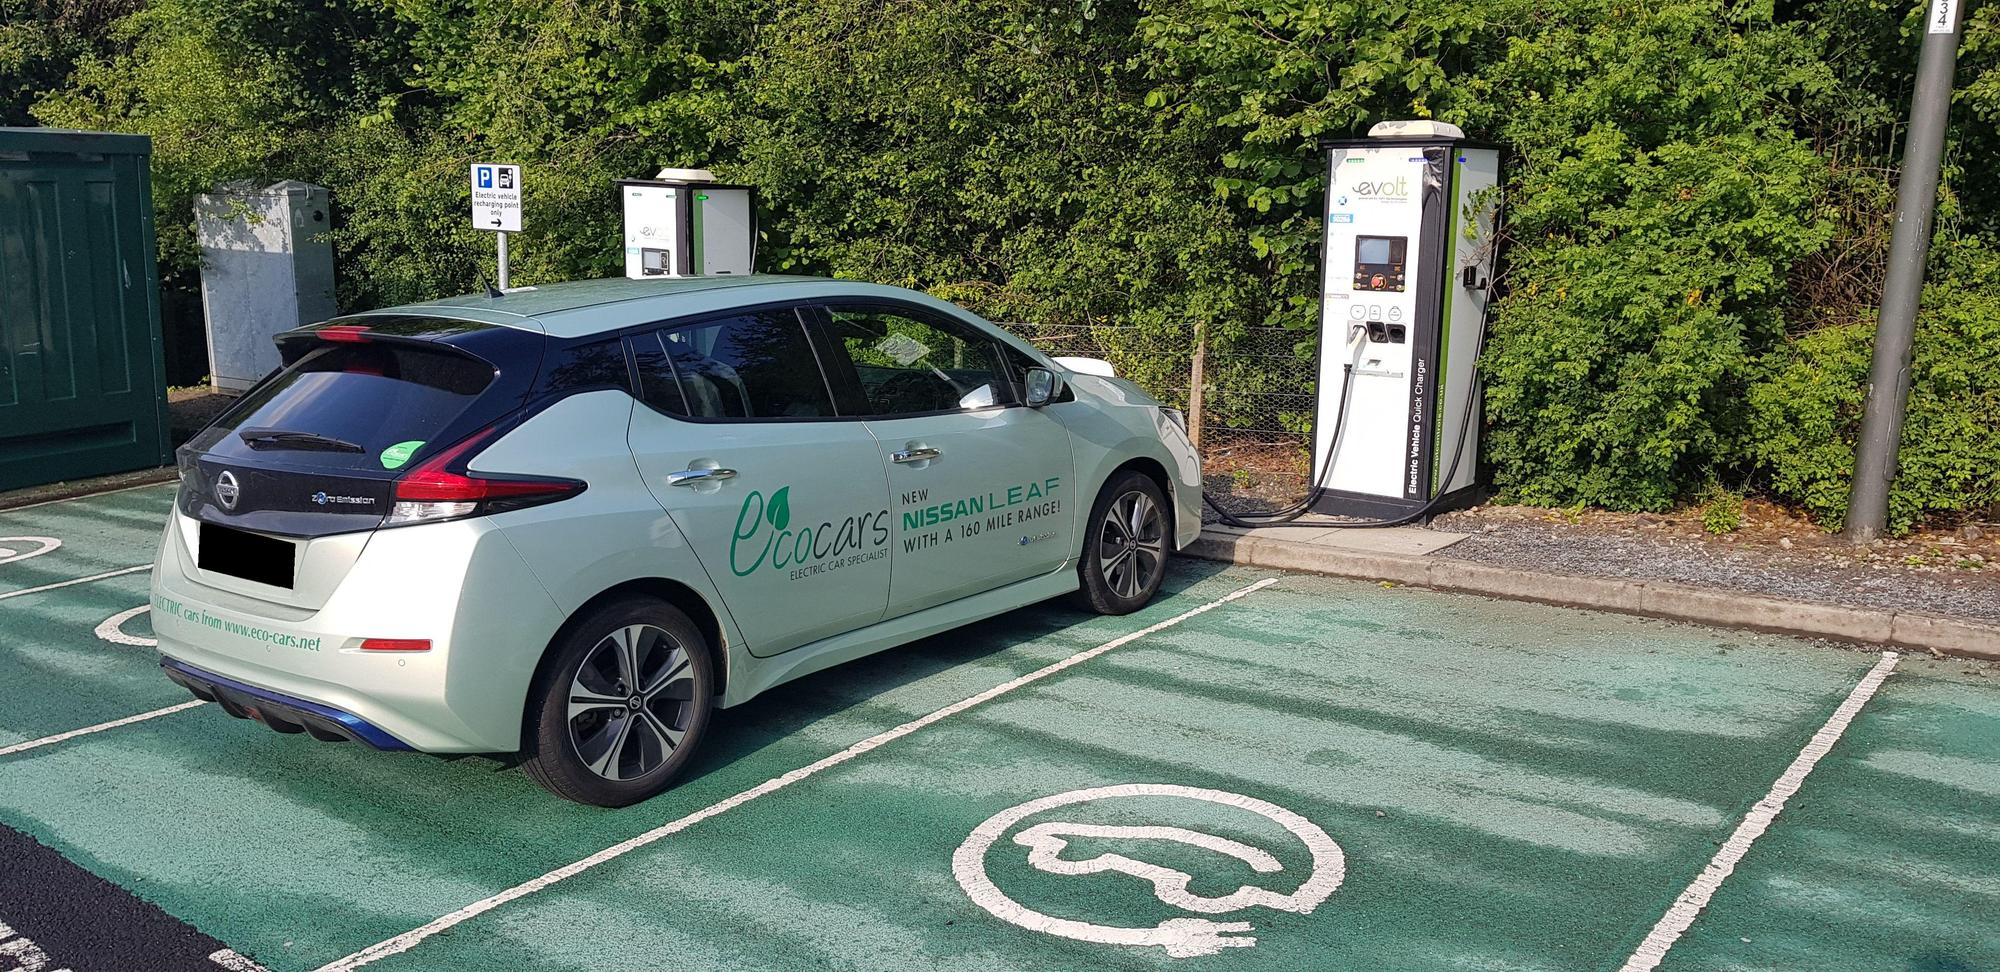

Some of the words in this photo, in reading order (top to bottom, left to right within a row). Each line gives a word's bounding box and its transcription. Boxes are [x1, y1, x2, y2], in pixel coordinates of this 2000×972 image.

[1938, 0, 1949, 26] 34
[480, 169, 490, 187] P
[1352, 176, 1408, 196] evolt
[474, 201, 503, 209] recharging
[475, 191, 496, 199] Electric
[490, 209, 502, 217] only
[1415, 358, 1426, 395] Charger
[1413, 397, 1422, 423] Quick
[1410, 425, 1421, 458] Vehicle
[1408, 459, 1419, 494] Electric
[336, 495, 375, 504] Emission
[902, 488, 929, 505] NEW
[903, 495, 984, 531] NISSAN
[989, 477, 1060, 510] LEAF
[903, 531, 938, 554] WITH
[944, 528, 953, 543] A
[961, 521, 980, 538] 160
[986, 512, 1012, 532] MILE
[1018, 499, 1061, 523] RANGE!
[790, 563, 826, 581] ELECTRIC
[828, 558, 845, 571] CAR
[847, 548, 888, 567] SPECIALIST
[184, 607, 200, 623] cars
[201, 609, 222, 630] from
[224, 620, 321, 652] www.eco-cars.net
